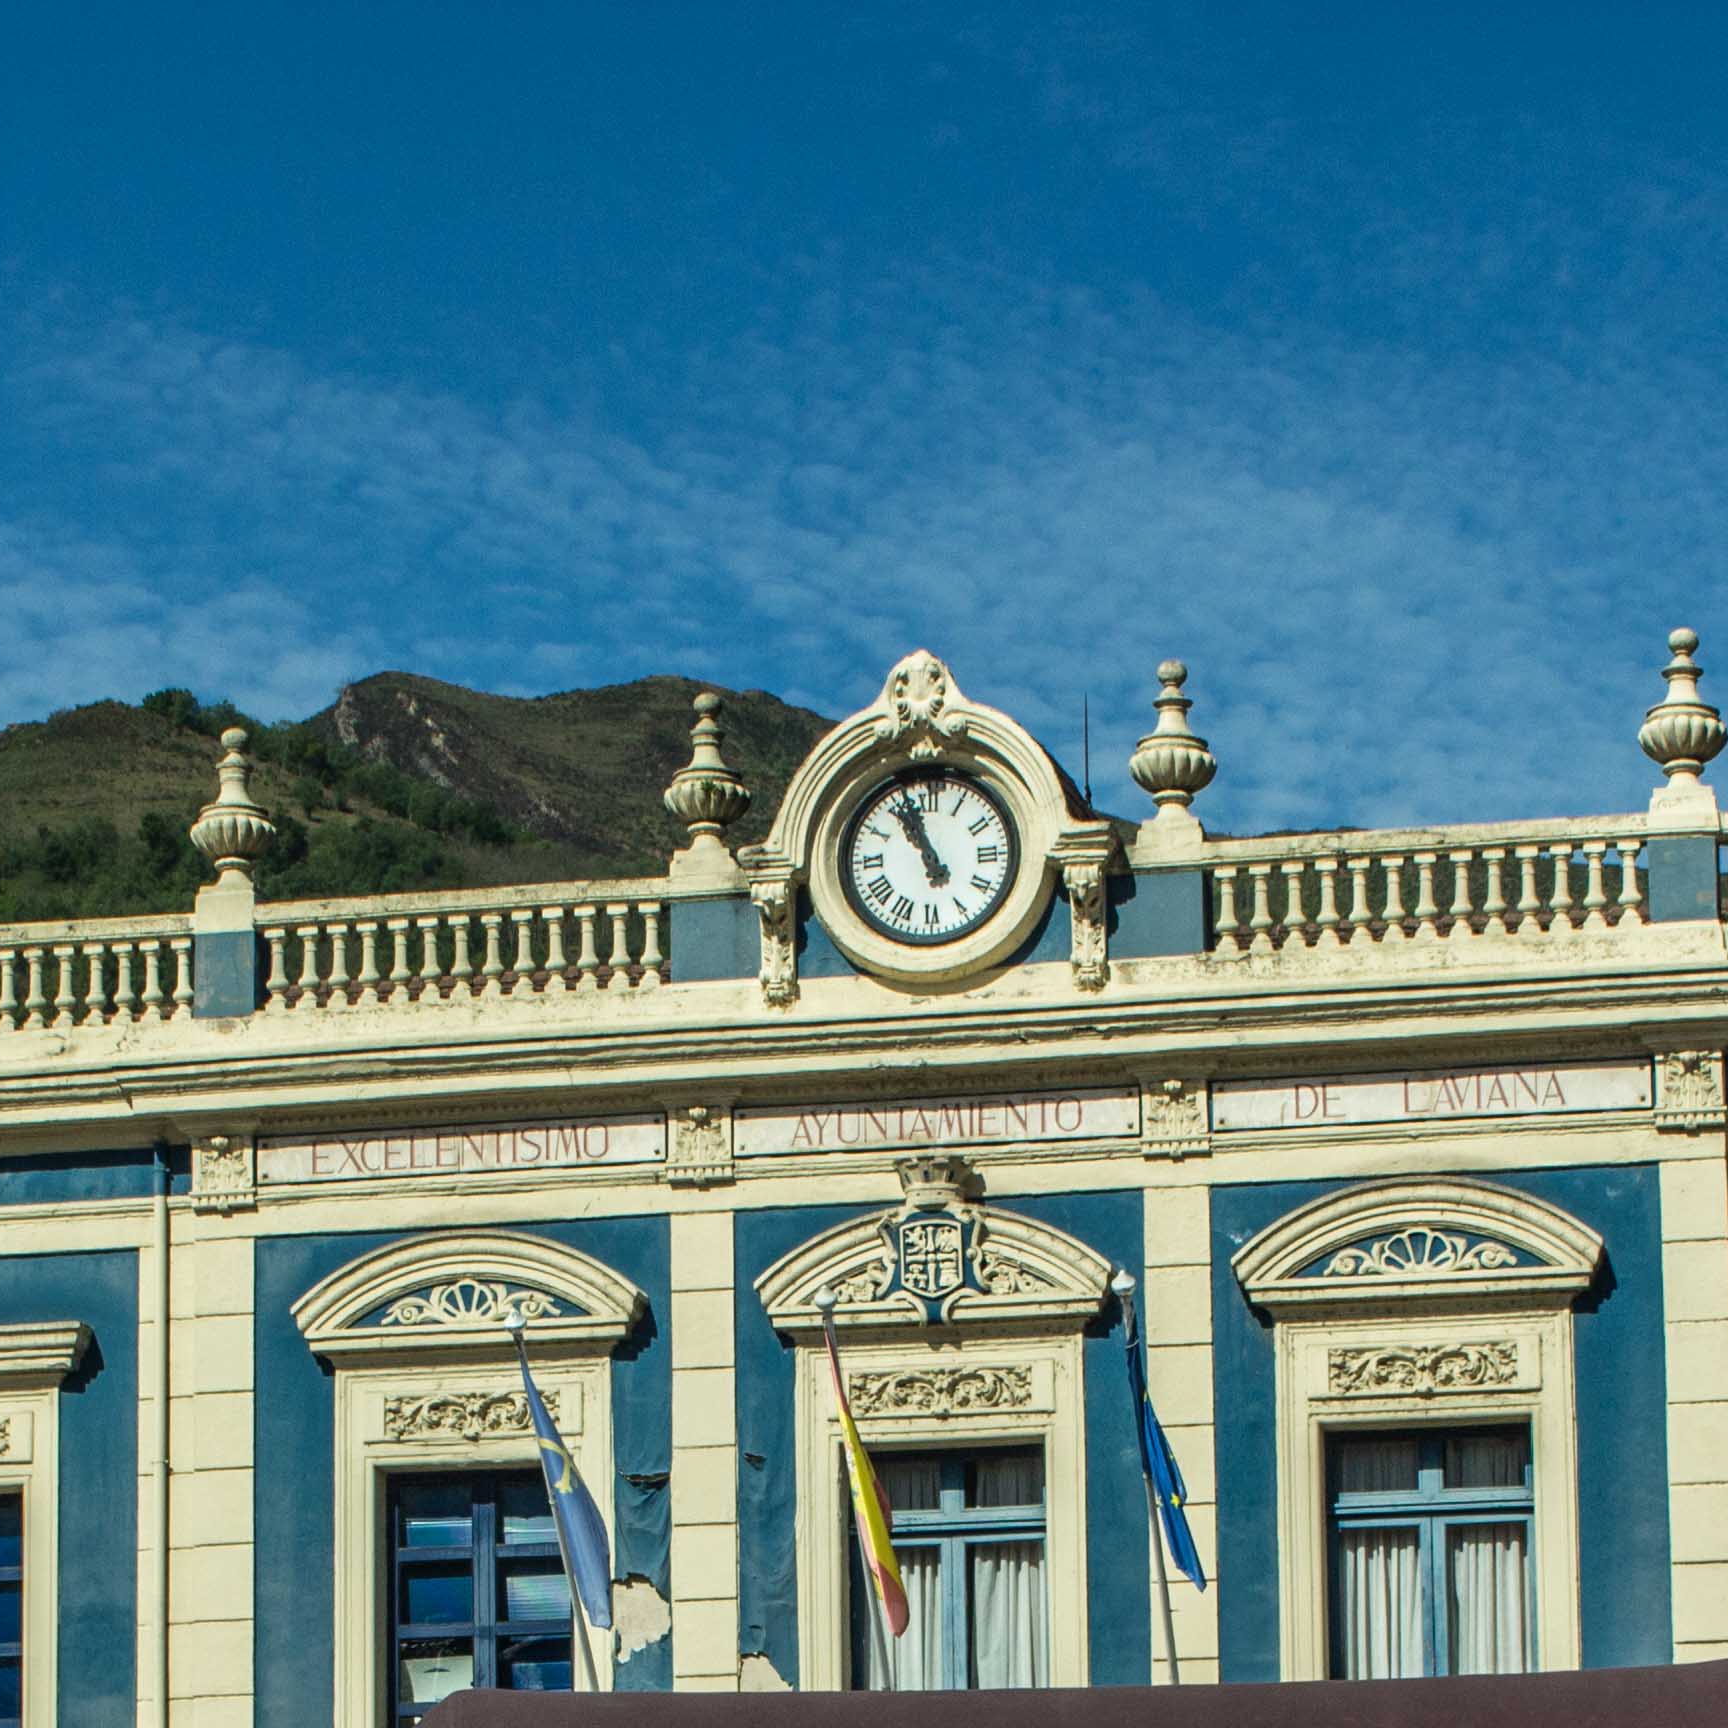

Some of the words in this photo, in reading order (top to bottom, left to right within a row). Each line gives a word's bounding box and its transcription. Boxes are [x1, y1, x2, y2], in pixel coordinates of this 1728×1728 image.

[312, 1124, 609, 1176] EXCELENTISIMO
[790, 1097, 1084, 1149] AYUNTAMIENTO
[1292, 1082, 1348, 1121] DE
[1401, 1068, 1566, 1113] LAVIANA
